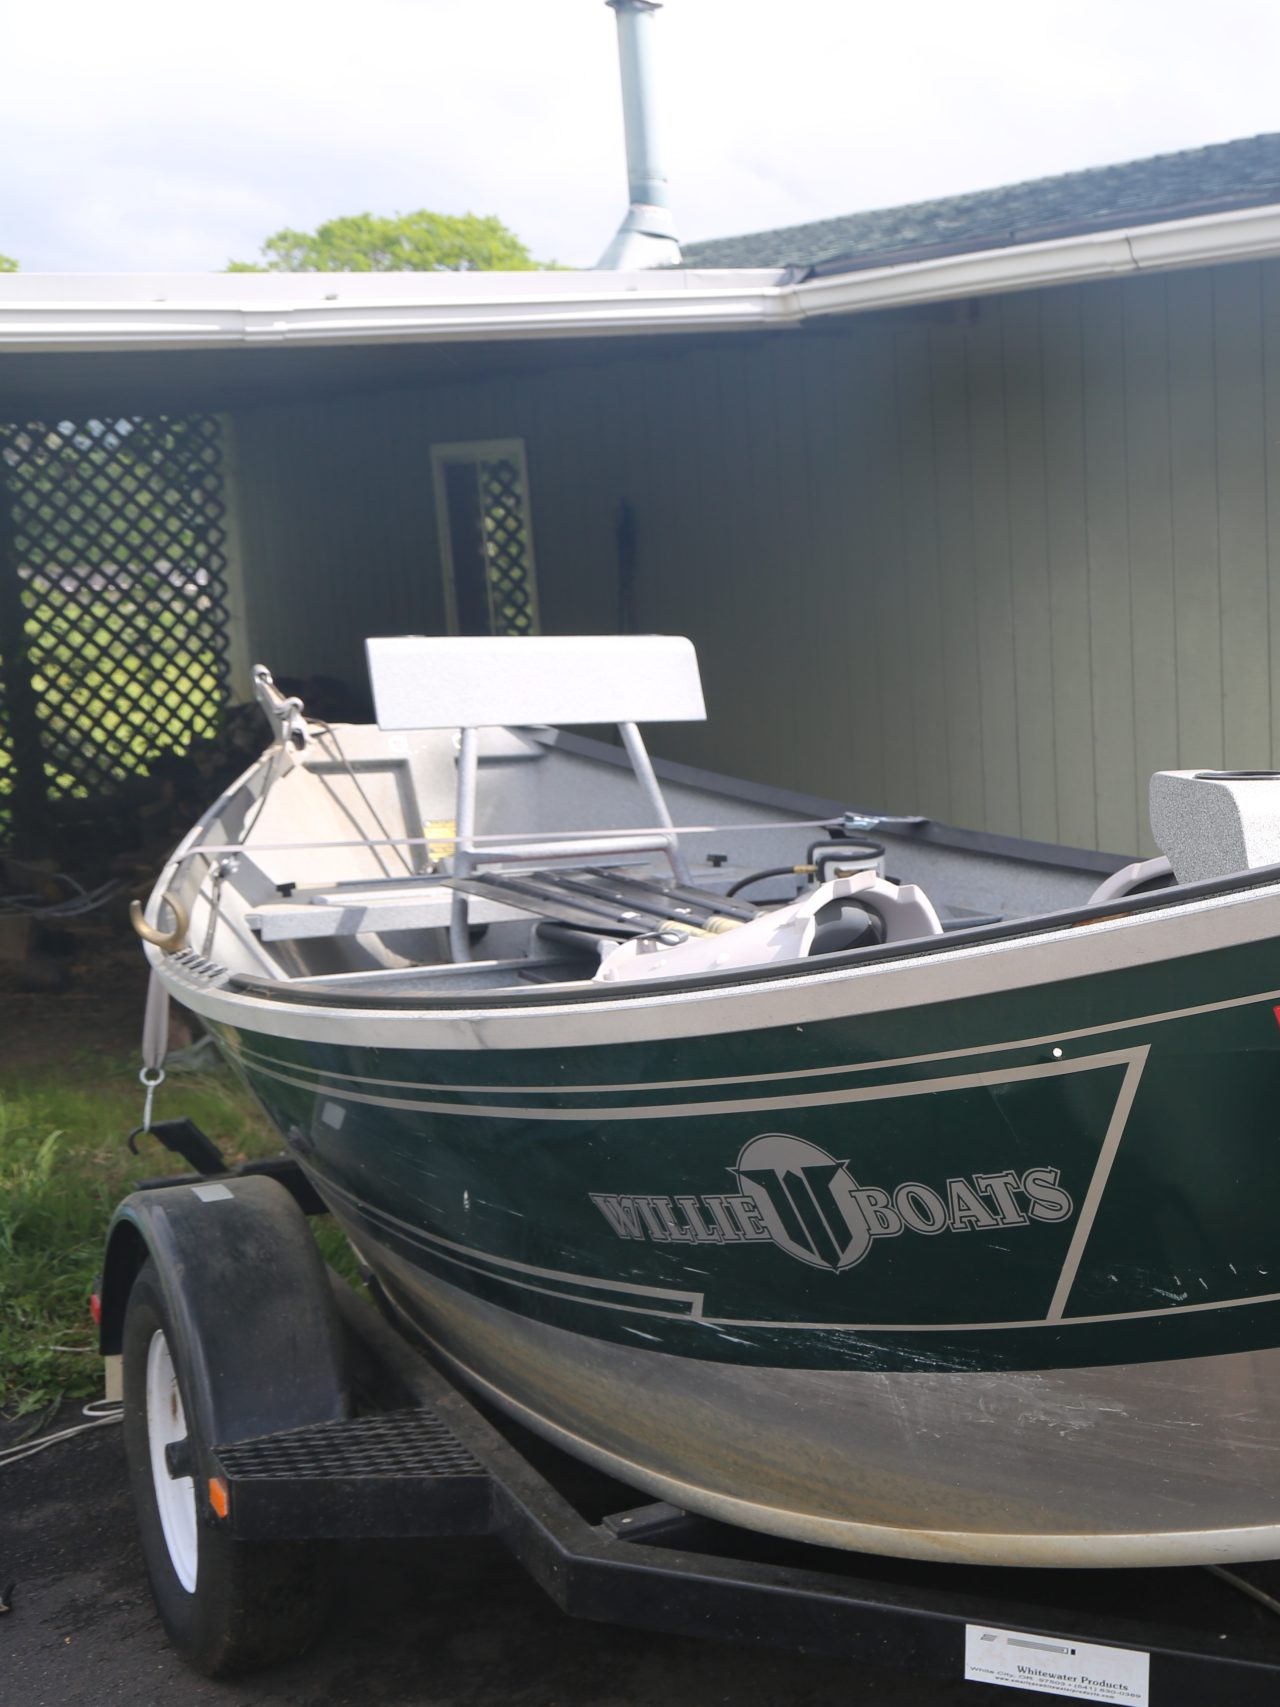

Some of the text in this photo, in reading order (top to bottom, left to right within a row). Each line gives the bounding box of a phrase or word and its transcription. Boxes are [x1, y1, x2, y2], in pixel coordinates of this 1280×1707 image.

[588, 1192, 774, 1244] WILLIE
[849, 1167, 1073, 1239] BOATS
[1017, 1664, 1129, 1692] Whitewater Products
